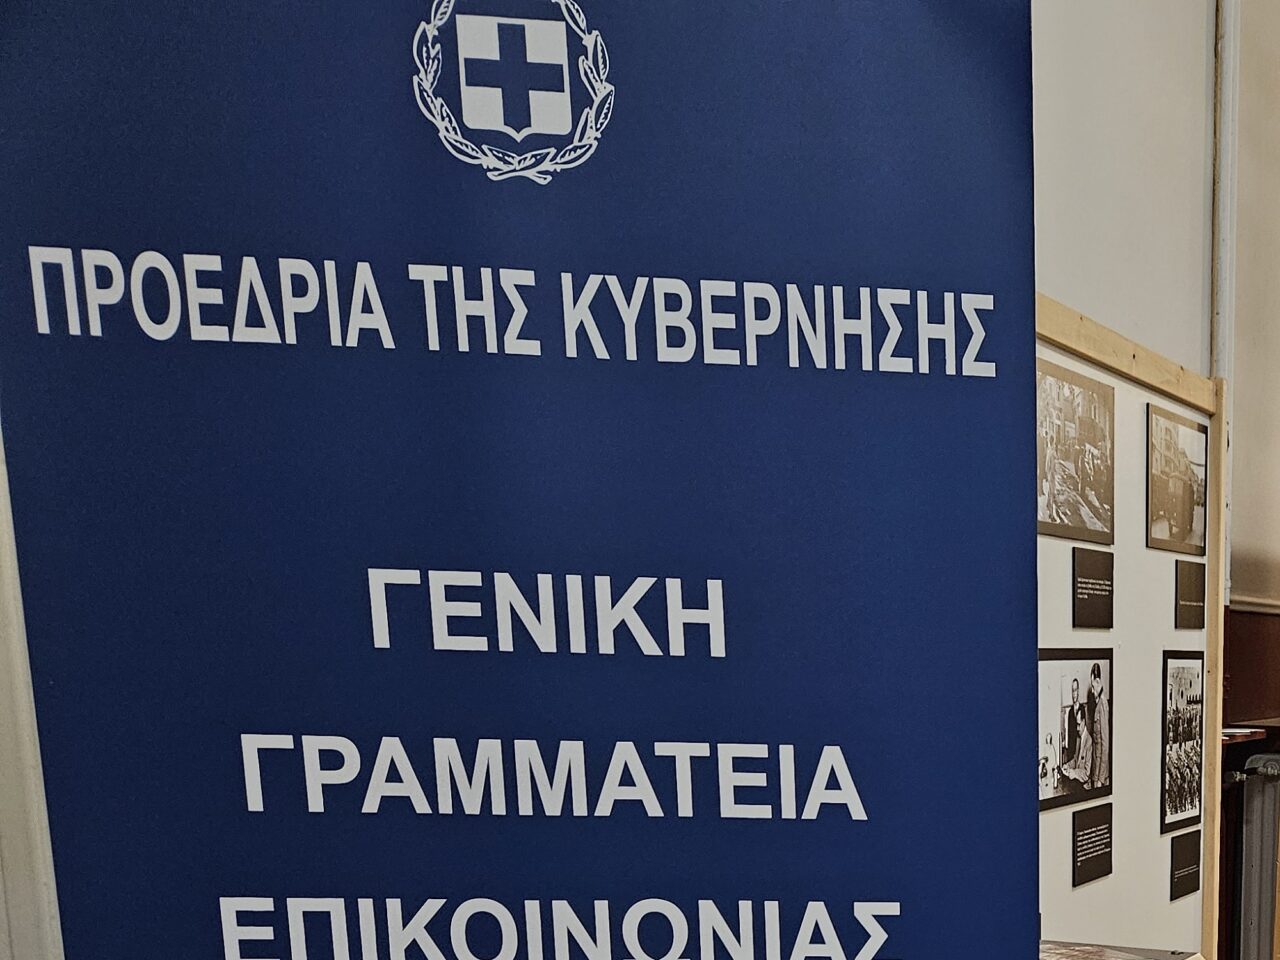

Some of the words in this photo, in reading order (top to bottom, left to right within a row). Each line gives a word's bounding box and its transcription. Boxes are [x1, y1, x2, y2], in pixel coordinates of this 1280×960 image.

[28, 245, 396, 349] ΠΡΟΕΔΡΙΑ
[407, 263, 542, 356] ΤΗΣ
[560, 272, 997, 378] ΚΥΒΕΡΝΗΣΗΣ
[367, 568, 726, 658] ΓΕΝΙΚΗ
[240, 733, 868, 821] ΓΡΑΜΜΑΤΕΙΑ
